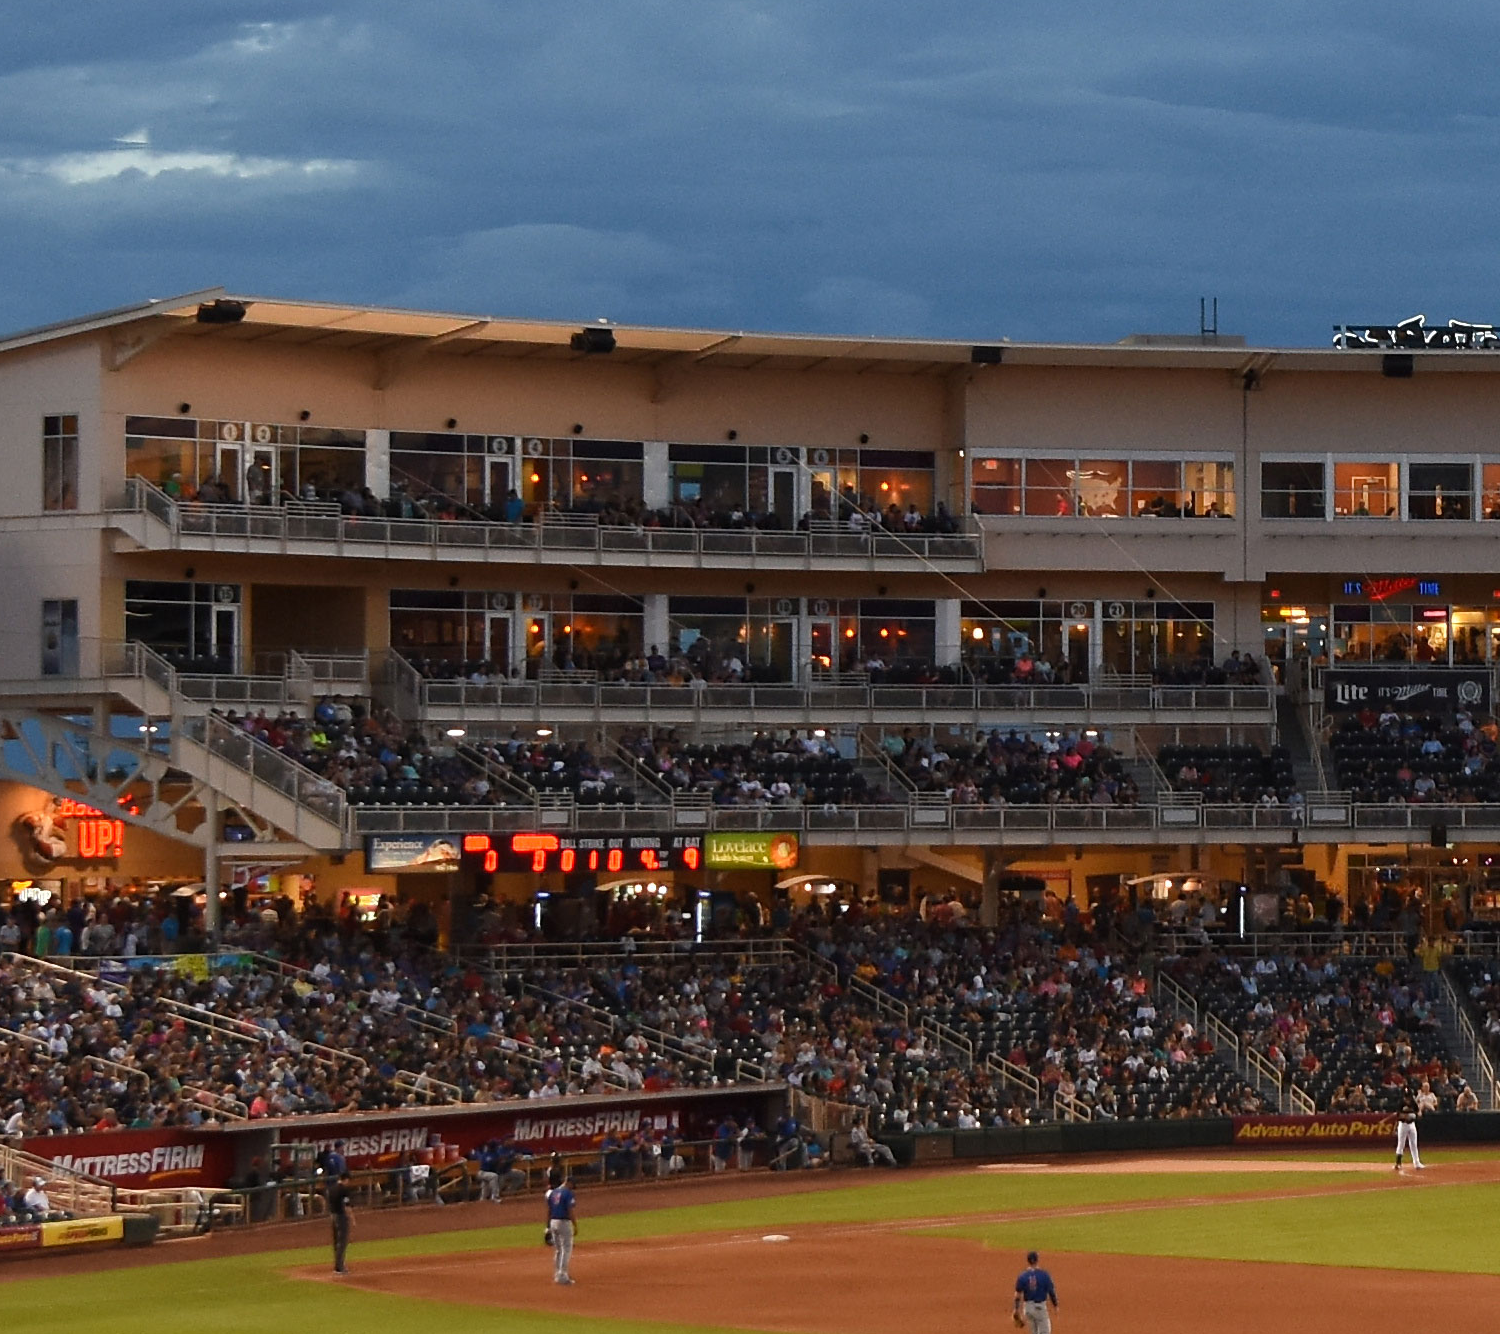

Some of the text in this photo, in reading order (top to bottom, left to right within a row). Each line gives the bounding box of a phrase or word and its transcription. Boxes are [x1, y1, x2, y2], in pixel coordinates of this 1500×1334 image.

[1073, 604, 1084, 615] 20
[1112, 604, 1122, 615] 21
[1336, 683, 1368, 704] Lite
[78, 819, 125, 859] UP!
[373, 837, 424, 851] Experience
[560, 839, 576, 848] BALL
[580, 839, 605, 848] STRIKE
[609, 839, 624, 848] OUT
[630, 837, 661, 849] INNING
[685, 837, 701, 848] BAT
[712, 839, 767, 853] Lovelace
[560, 849, 575, 872] 0
[589, 849, 598, 870] 1
[607, 849, 623, 872] 0
[683, 848, 699, 870] 9
[514, 1110, 641, 1140] MATTRESSFIRM
[1238, 1121, 1392, 1138] Advance Auto Parts
